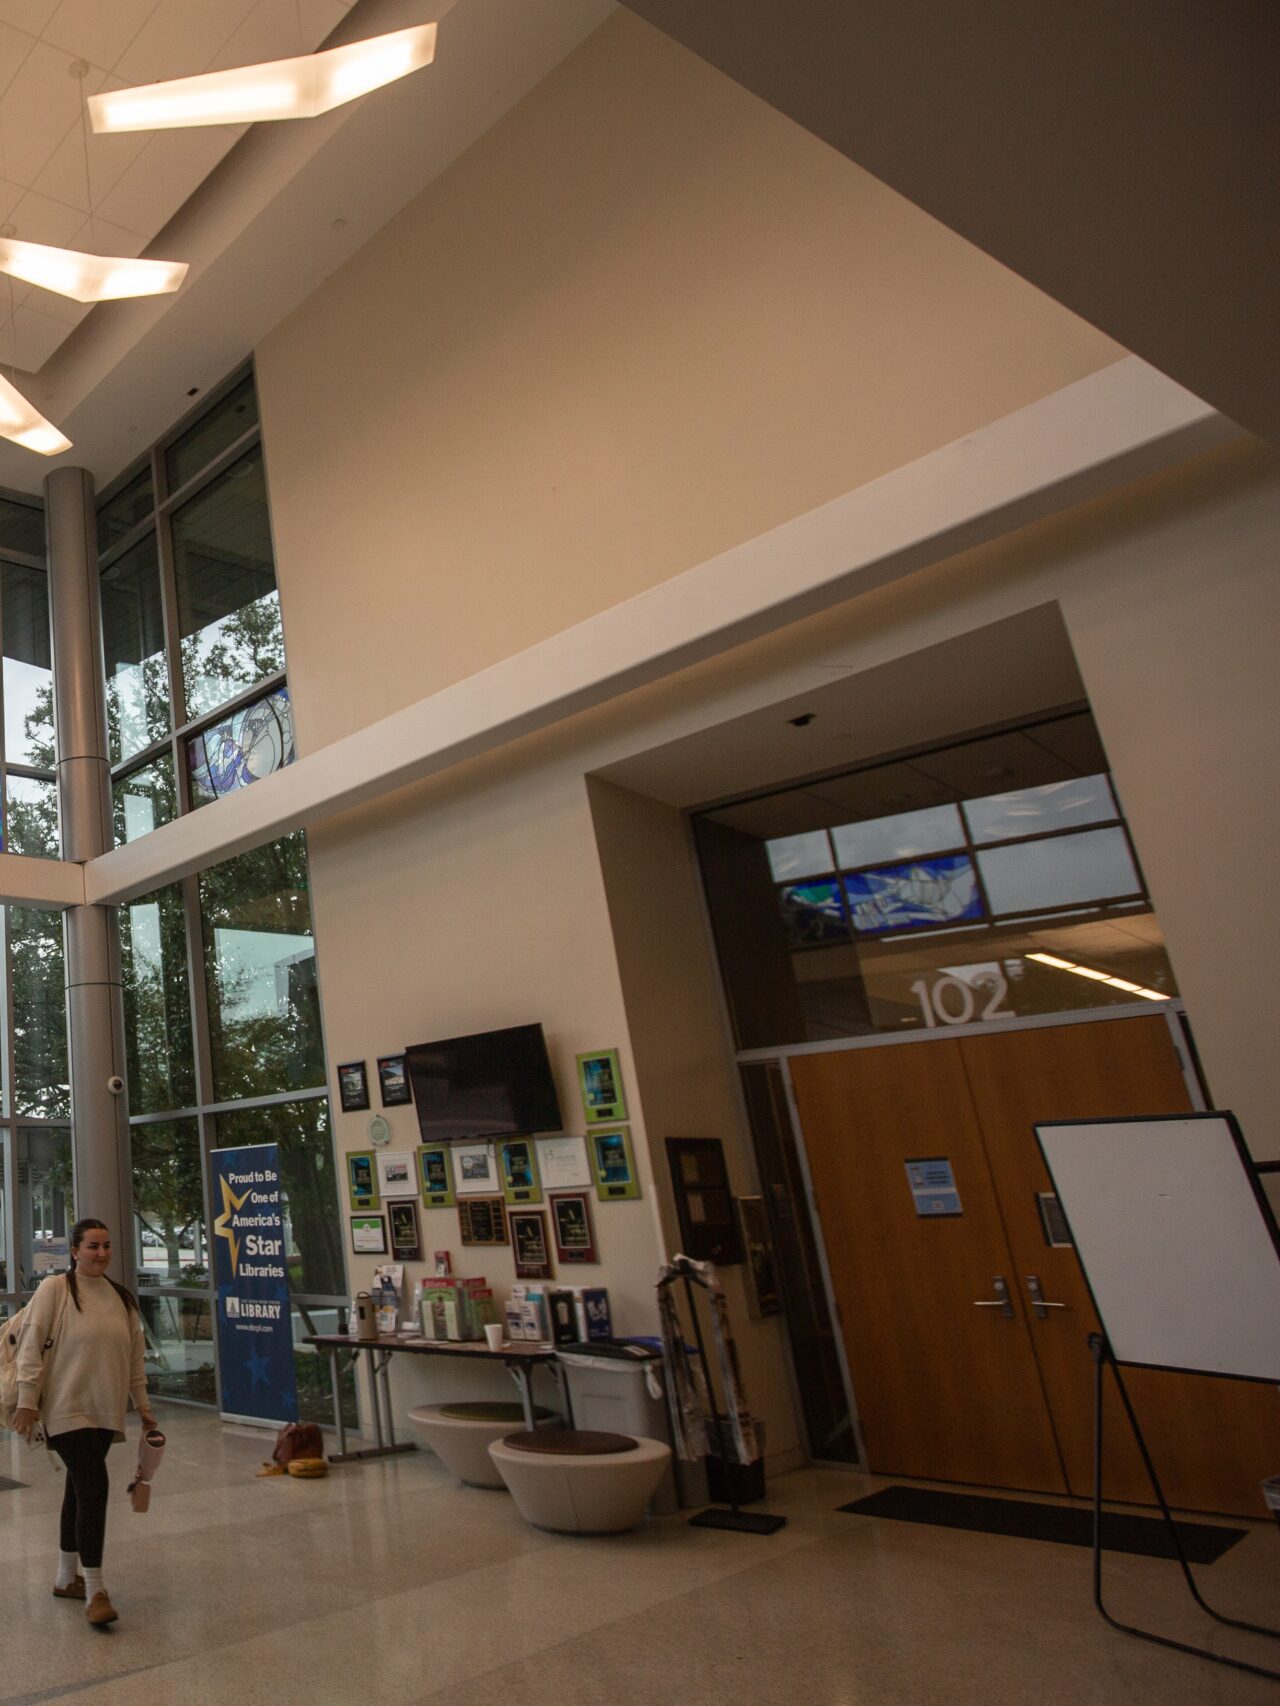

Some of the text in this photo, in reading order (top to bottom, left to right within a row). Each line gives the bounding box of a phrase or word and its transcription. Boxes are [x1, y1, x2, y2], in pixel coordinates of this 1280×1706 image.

[910, 971, 1016, 1028] 102
[228, 1170, 277, 1184] Proud to Be
[251, 1191, 279, 1203] One of
[232, 1213, 281, 1227] America's
[245, 1235, 282, 1256] Star
[239, 1263, 285, 1278] Libraries
[240, 1303, 281, 1319] LIBRARY
